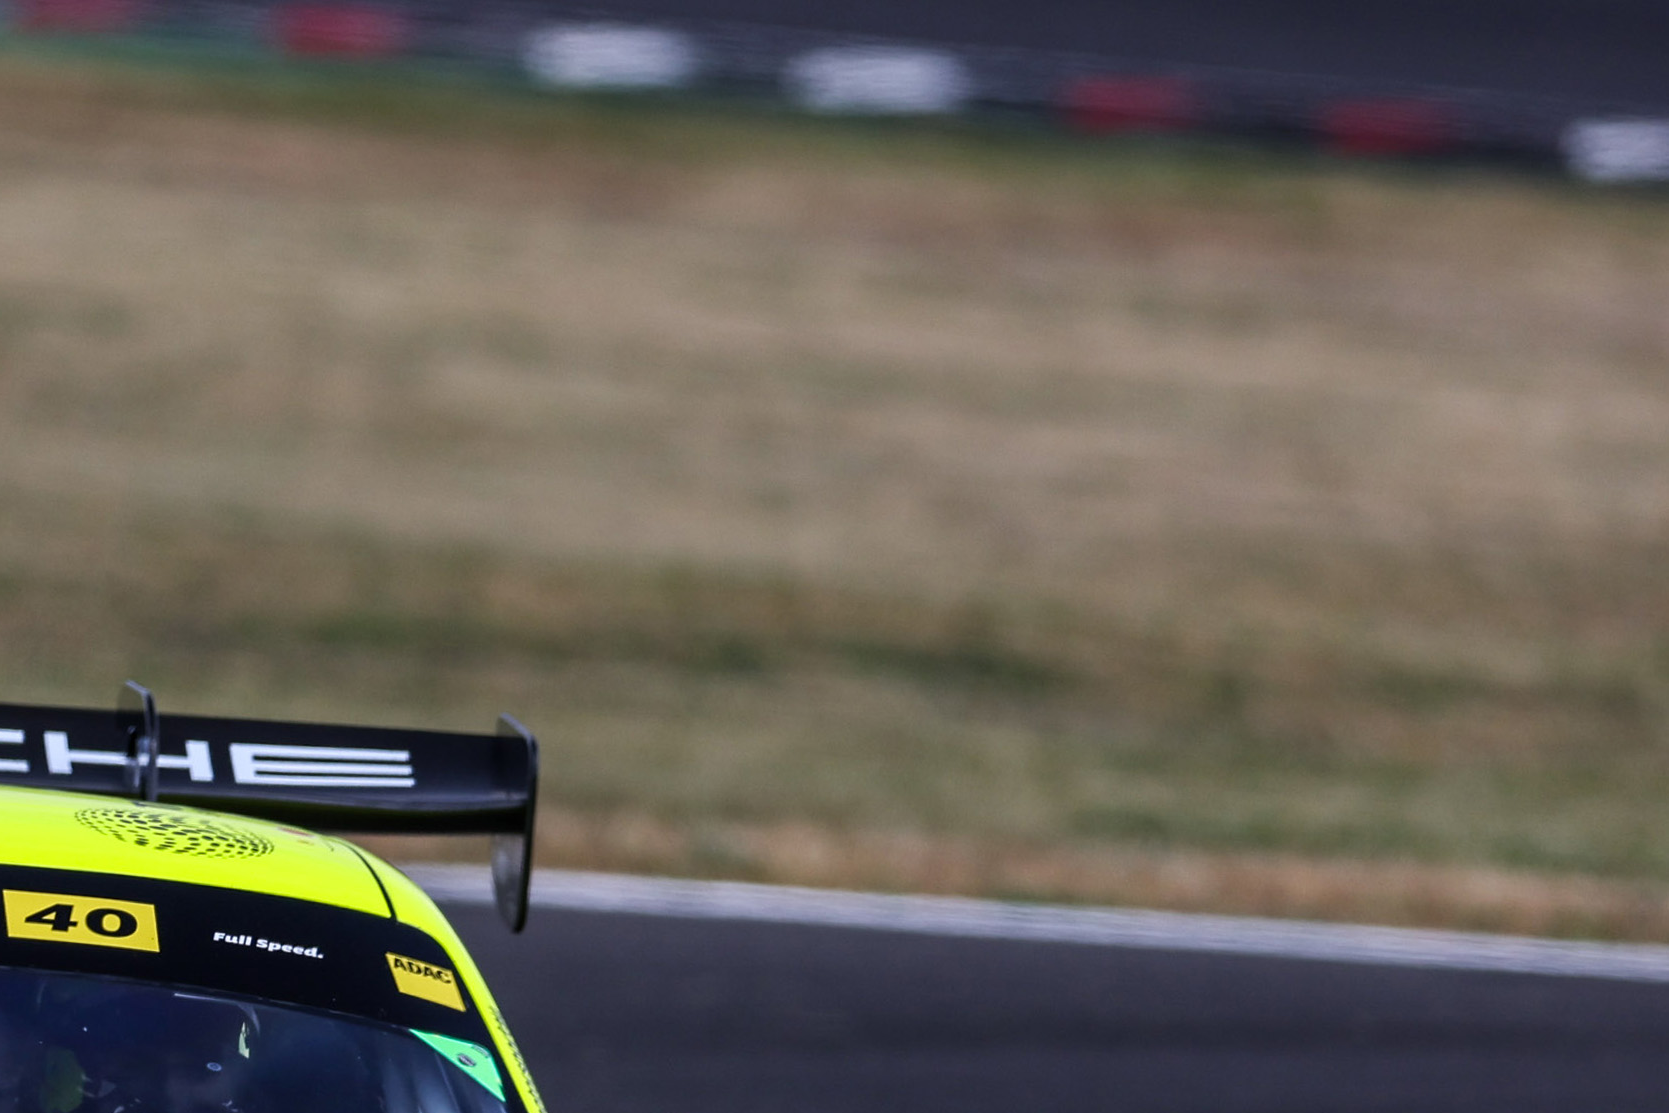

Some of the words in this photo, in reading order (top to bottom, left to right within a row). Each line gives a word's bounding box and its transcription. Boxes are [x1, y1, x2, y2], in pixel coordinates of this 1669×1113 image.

[24, 903, 138, 938] 40
[213, 931, 252, 946] Full
[256, 938, 324, 959] Speed.
[393, 957, 452, 984] ADAC
